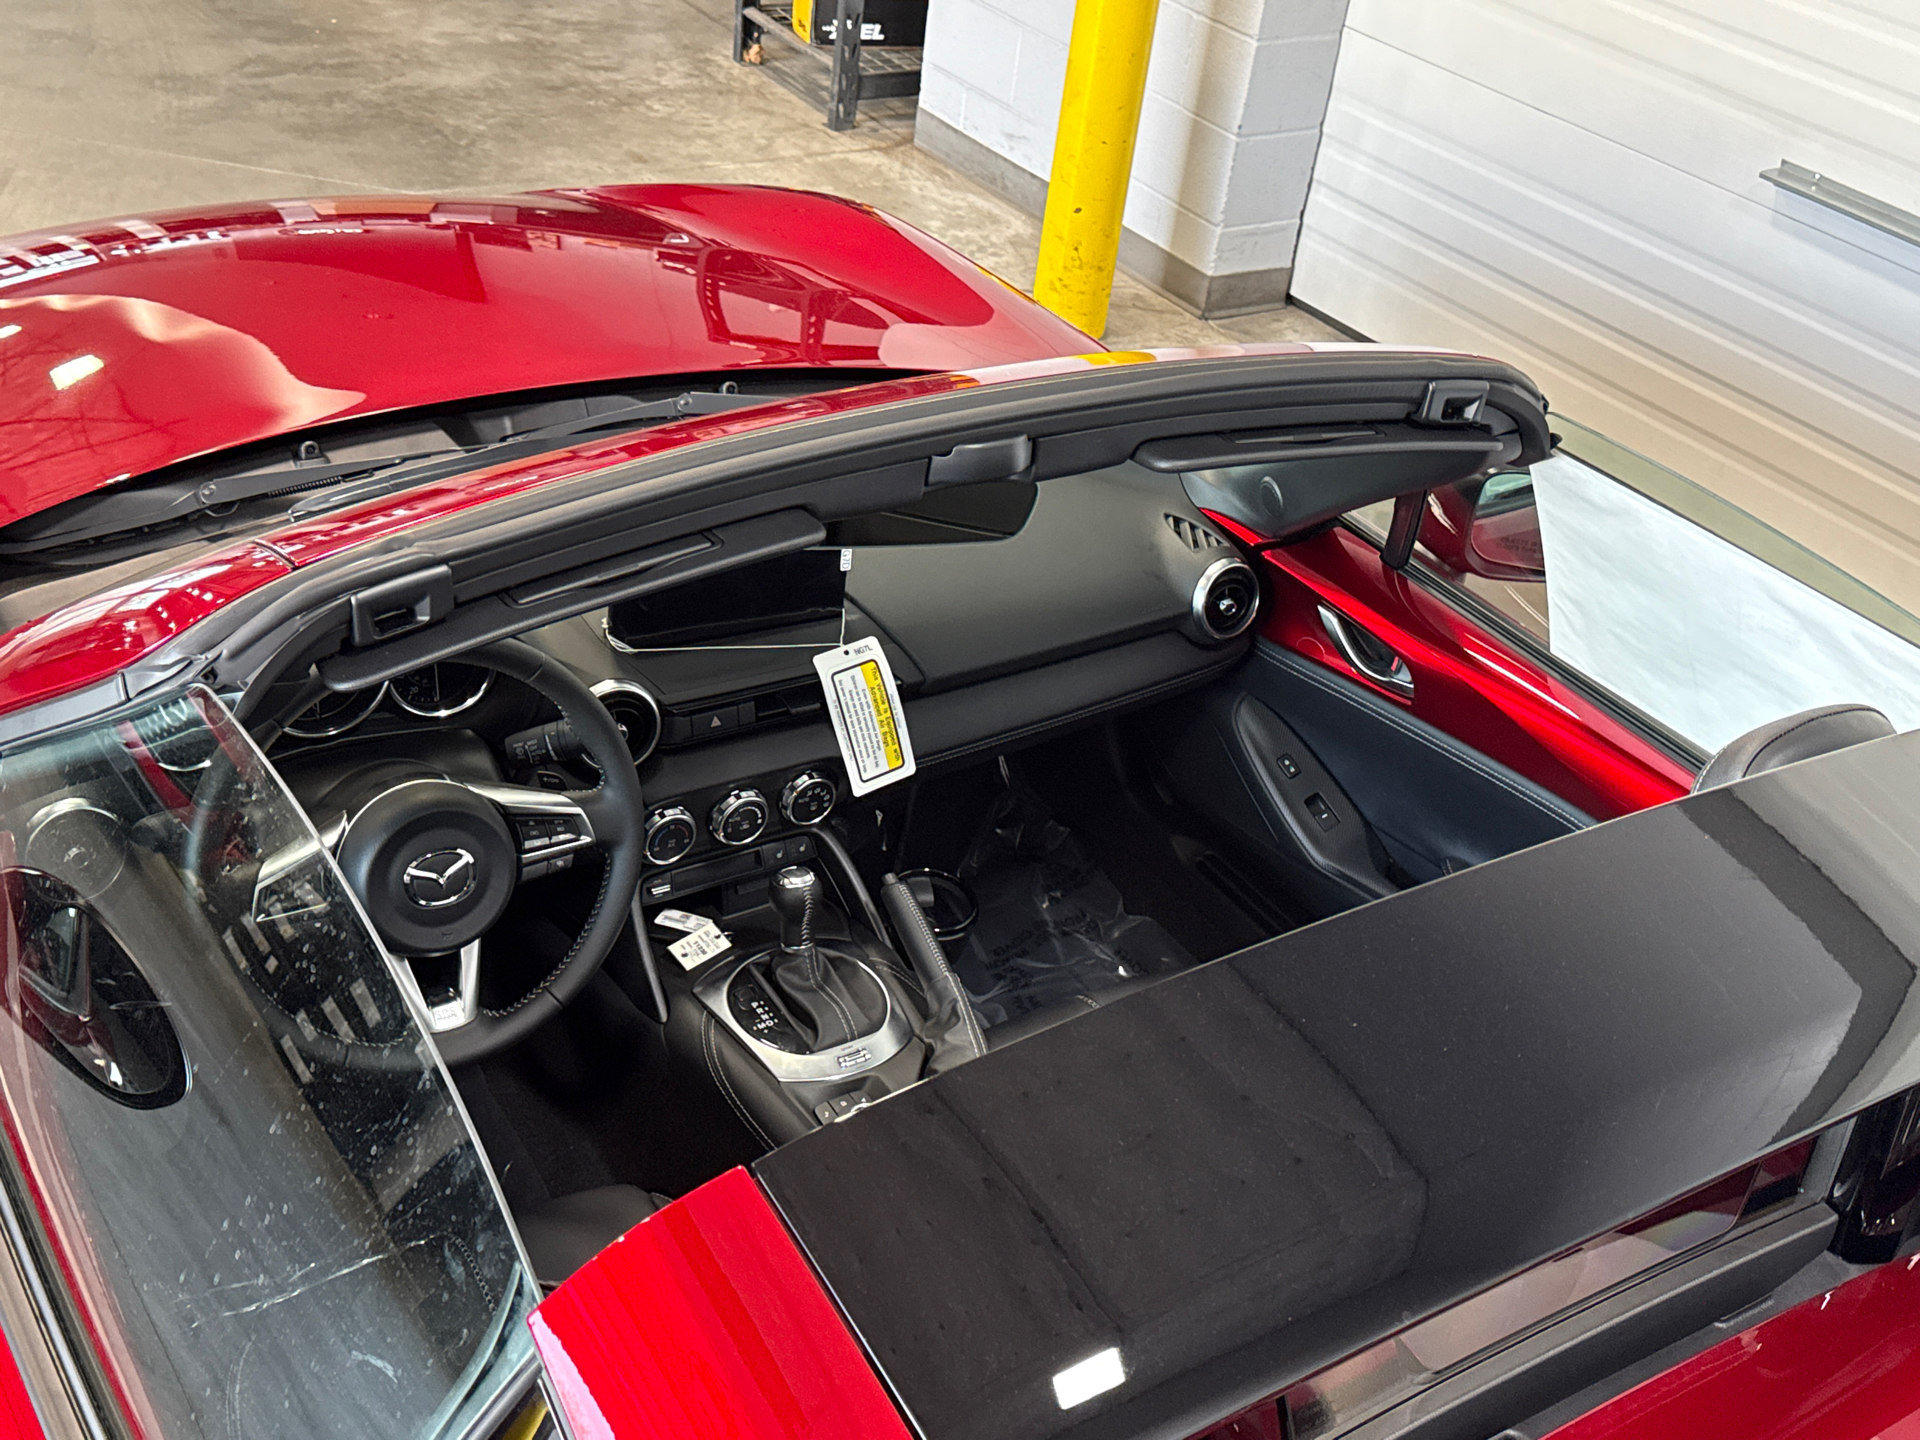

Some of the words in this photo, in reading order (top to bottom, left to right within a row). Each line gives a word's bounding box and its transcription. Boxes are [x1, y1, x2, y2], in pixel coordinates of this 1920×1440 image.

[869, 686, 883, 717] Advanced
[870, 667, 879, 681] This
[875, 683, 887, 706] Vehicle
[883, 716, 899, 746] Equipped
[893, 748, 902, 762] with
[878, 719, 886, 729] Air
[880, 731, 891, 748] Bags
